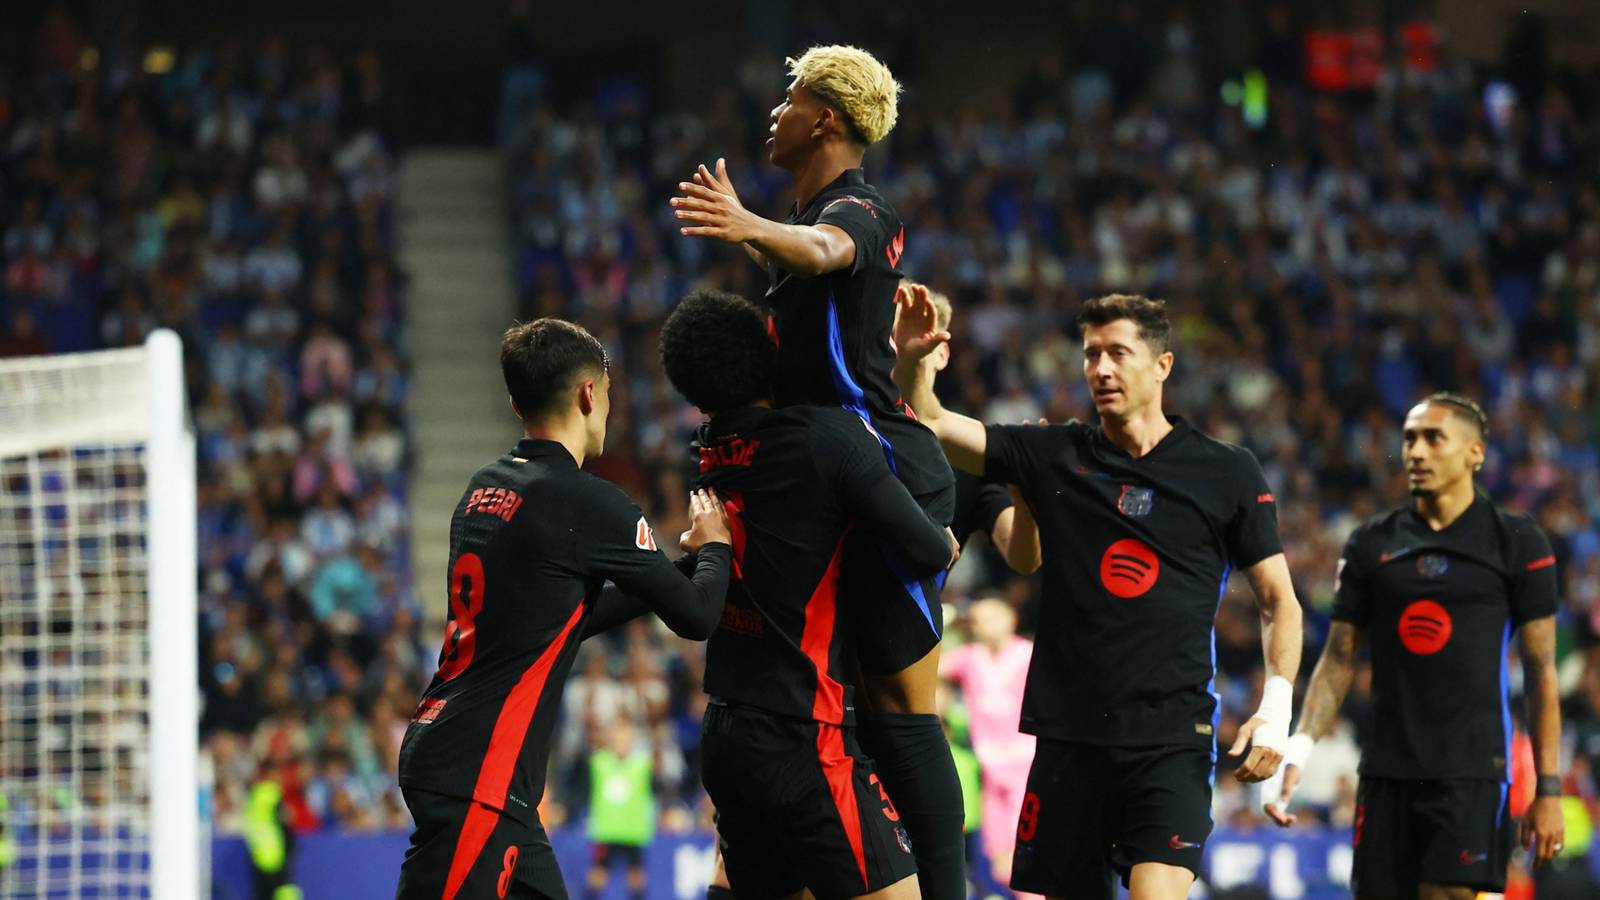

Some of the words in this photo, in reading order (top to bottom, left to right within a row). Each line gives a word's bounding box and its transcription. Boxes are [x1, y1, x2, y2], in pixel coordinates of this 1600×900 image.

[464, 487, 523, 522] PEDRI
[435, 552, 485, 682] 8
[869, 773, 899, 821] 3
[1020, 792, 1040, 841] 9
[497, 845, 519, 899] 8
